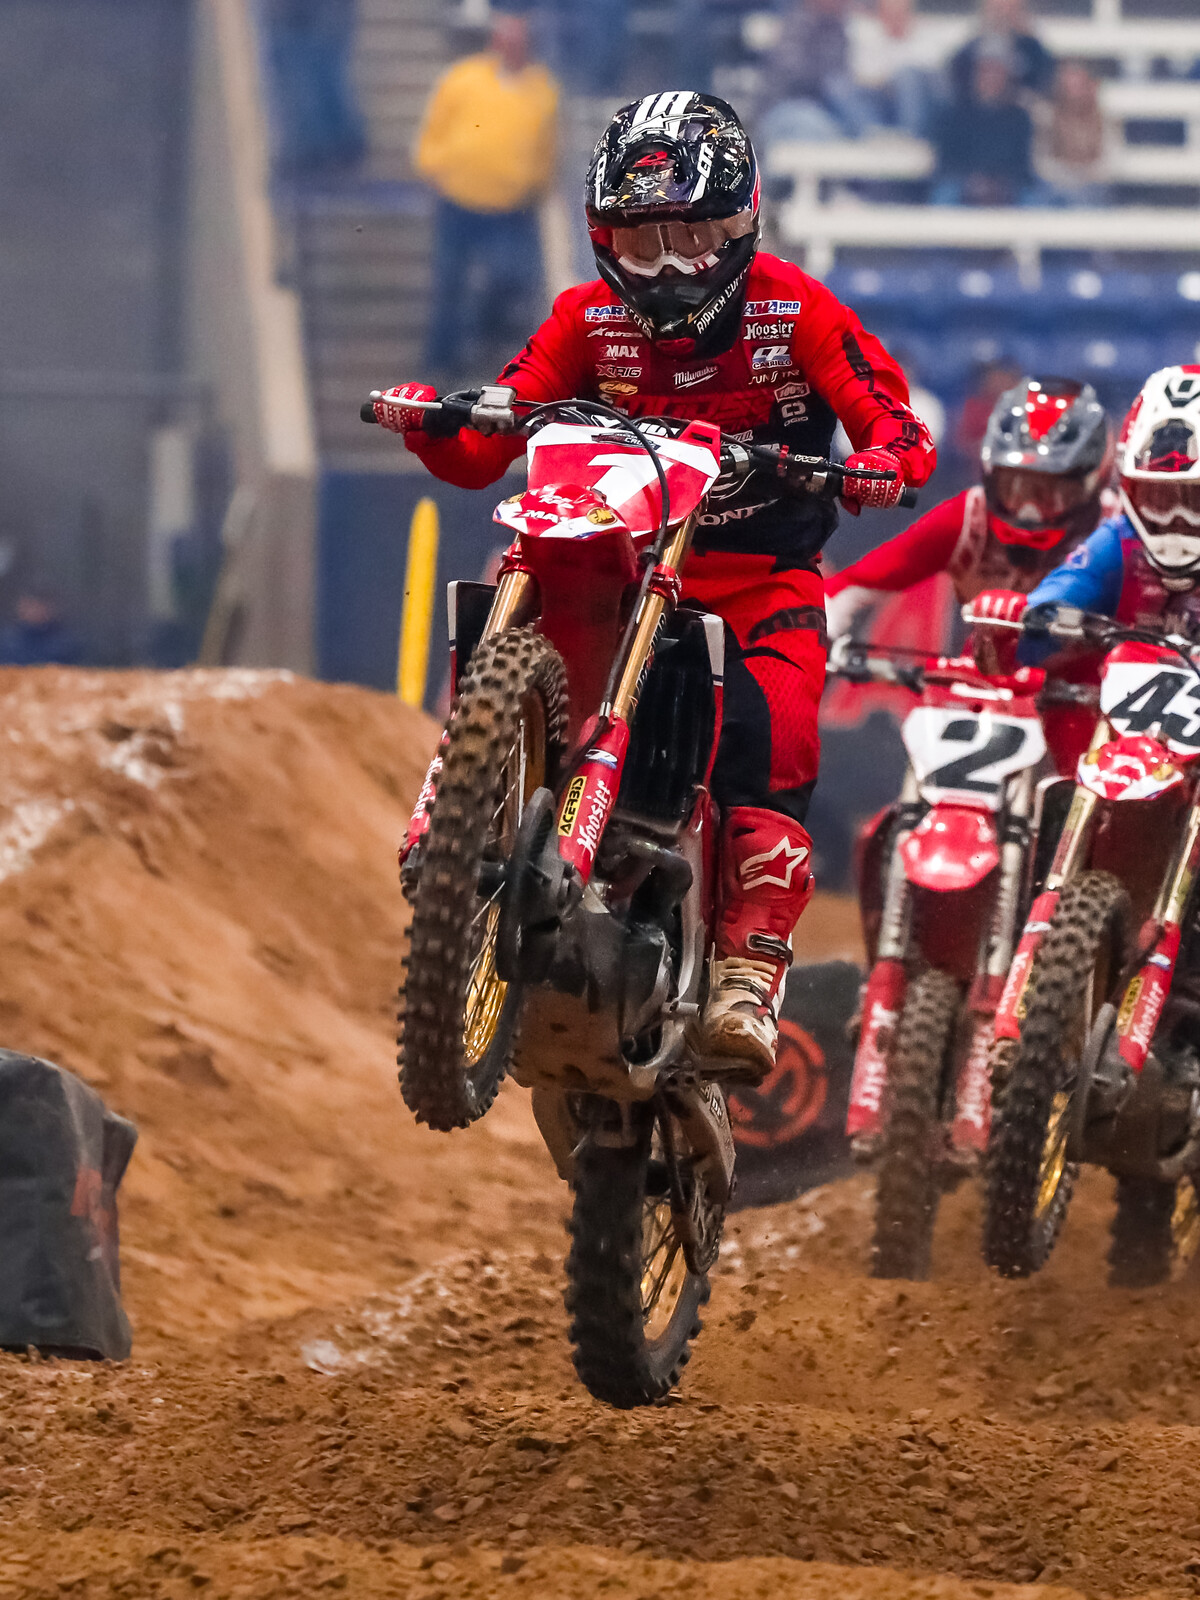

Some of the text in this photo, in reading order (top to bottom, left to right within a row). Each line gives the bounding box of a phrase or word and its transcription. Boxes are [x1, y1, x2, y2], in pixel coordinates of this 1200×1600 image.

[585, 306, 626, 316] PAR
[779, 301, 800, 310] PRO
[743, 319, 795, 340] Hoosier
[595, 364, 642, 378] XTRIG
[673, 365, 718, 386] Milwaukee
[926, 719, 1026, 793] 2
[559, 777, 585, 835] ACERBIS
[576, 779, 611, 861] Hoosier
